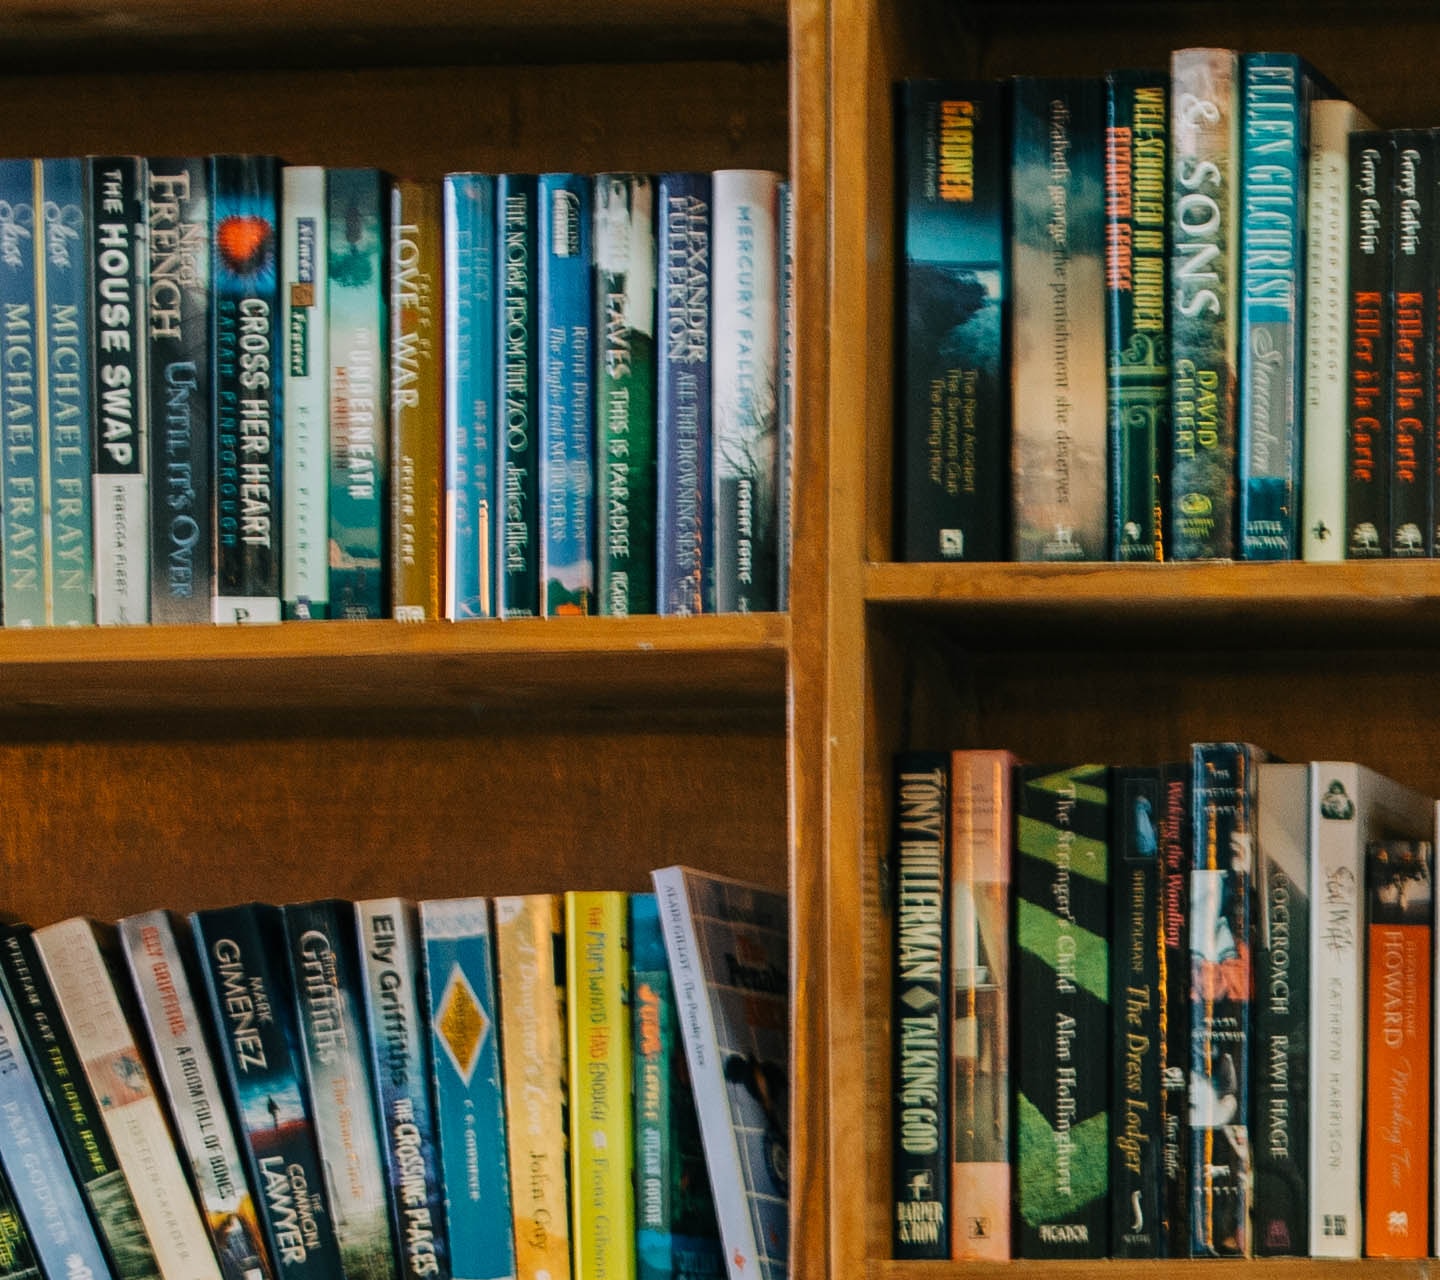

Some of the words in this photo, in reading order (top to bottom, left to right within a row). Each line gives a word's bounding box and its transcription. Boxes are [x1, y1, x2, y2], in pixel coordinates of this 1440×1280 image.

[939, 101, 974, 200] GARDNER
[1179, 93, 1220, 130] &
[1247, 66, 1292, 153] ELLEN
[104, 169, 124, 214] THE
[1249, 165, 1293, 308] GILCHRIST
[1176, 161, 1220, 317] SONS
[102, 223, 131, 352] HOUSE
[53, 304, 80, 463] MICHAEL
[240, 299, 270, 385] CROSS
[104, 364, 133, 464] SWAP
[241, 398, 269, 453] HER
[55, 478, 82, 592] FRAYN
[242, 464, 271, 548] HEART
[901, 769, 941, 832] TONY
[370, 914, 395, 963] Elly
[900, 838, 941, 981] HILLERMAN
[379, 971, 410, 1089] Griffiths
[902, 1013, 939, 1103] TALKING
[901, 1108, 938, 1152] GOD
[261, 1156, 307, 1265] LAWYER
